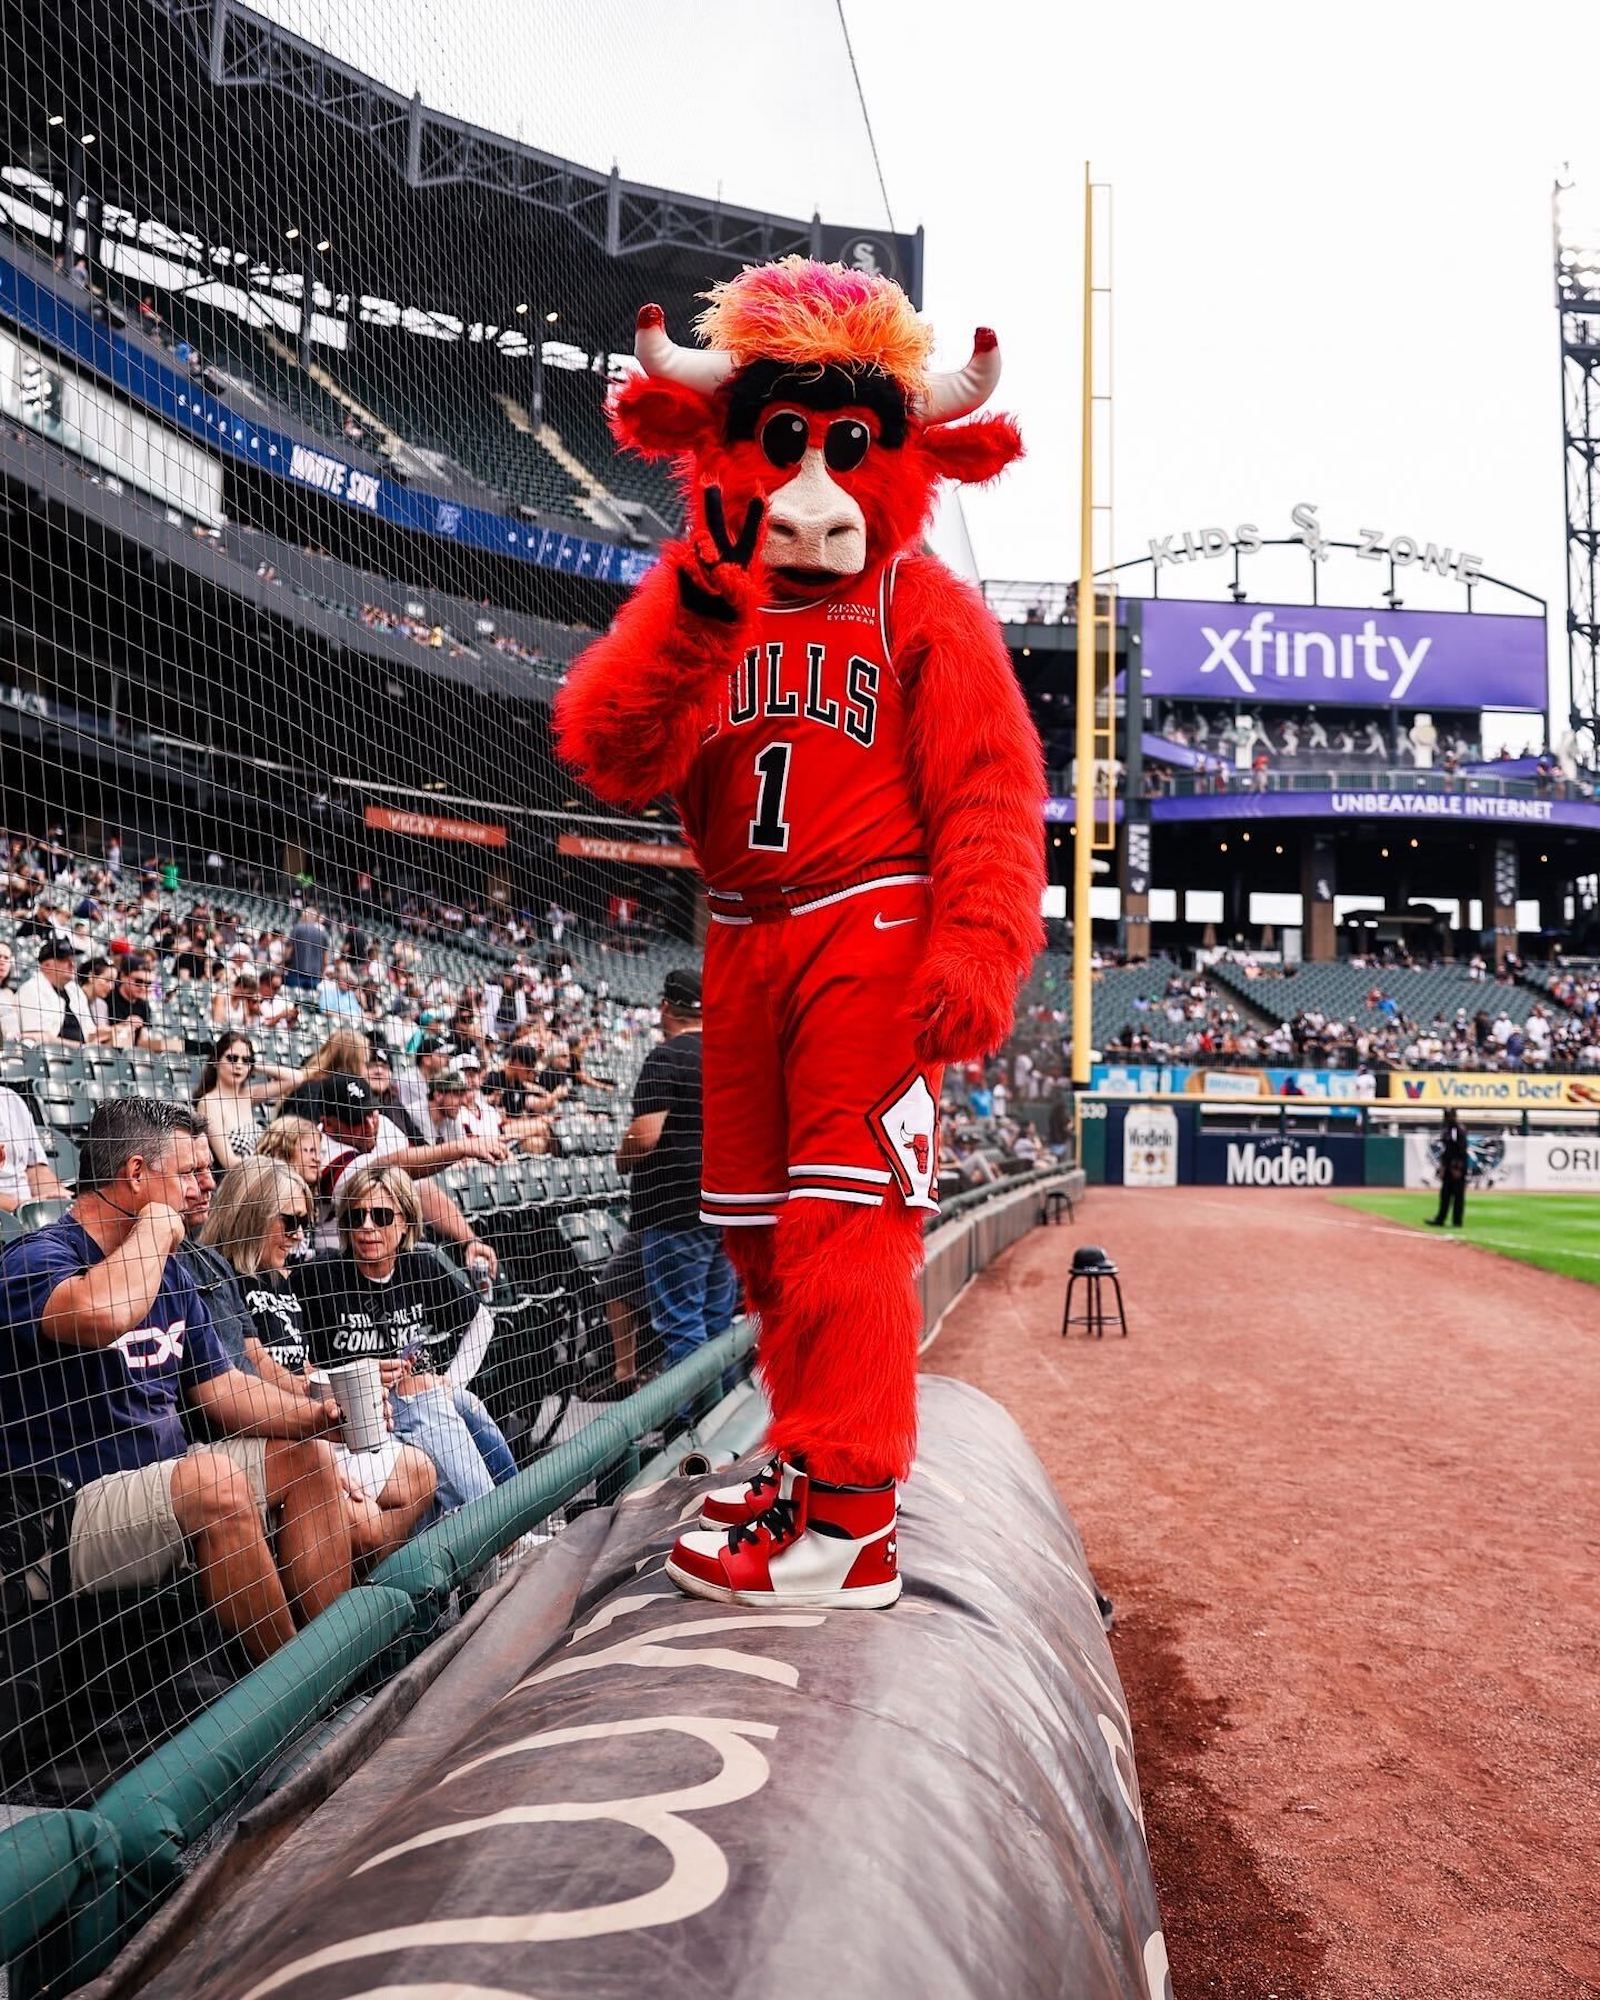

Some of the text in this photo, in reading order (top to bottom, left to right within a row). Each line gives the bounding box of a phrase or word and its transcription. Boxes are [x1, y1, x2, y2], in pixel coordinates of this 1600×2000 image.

[1148, 524, 1263, 568] KIDS
[1356, 529, 1483, 585] ZONE
[827, 614, 875, 626] EYEWEAR
[1200, 611, 1432, 699] xfinity
[702, 642, 880, 748] ULLS
[749, 741, 792, 852] 1
[1332, 793, 1554, 820] UNBEATABLE INTERNET
[1438, 1077, 1562, 1099] Vienna Beef
[1226, 1142, 1334, 1186] Modelo
[333, 1322, 422, 1352] COMIKE
